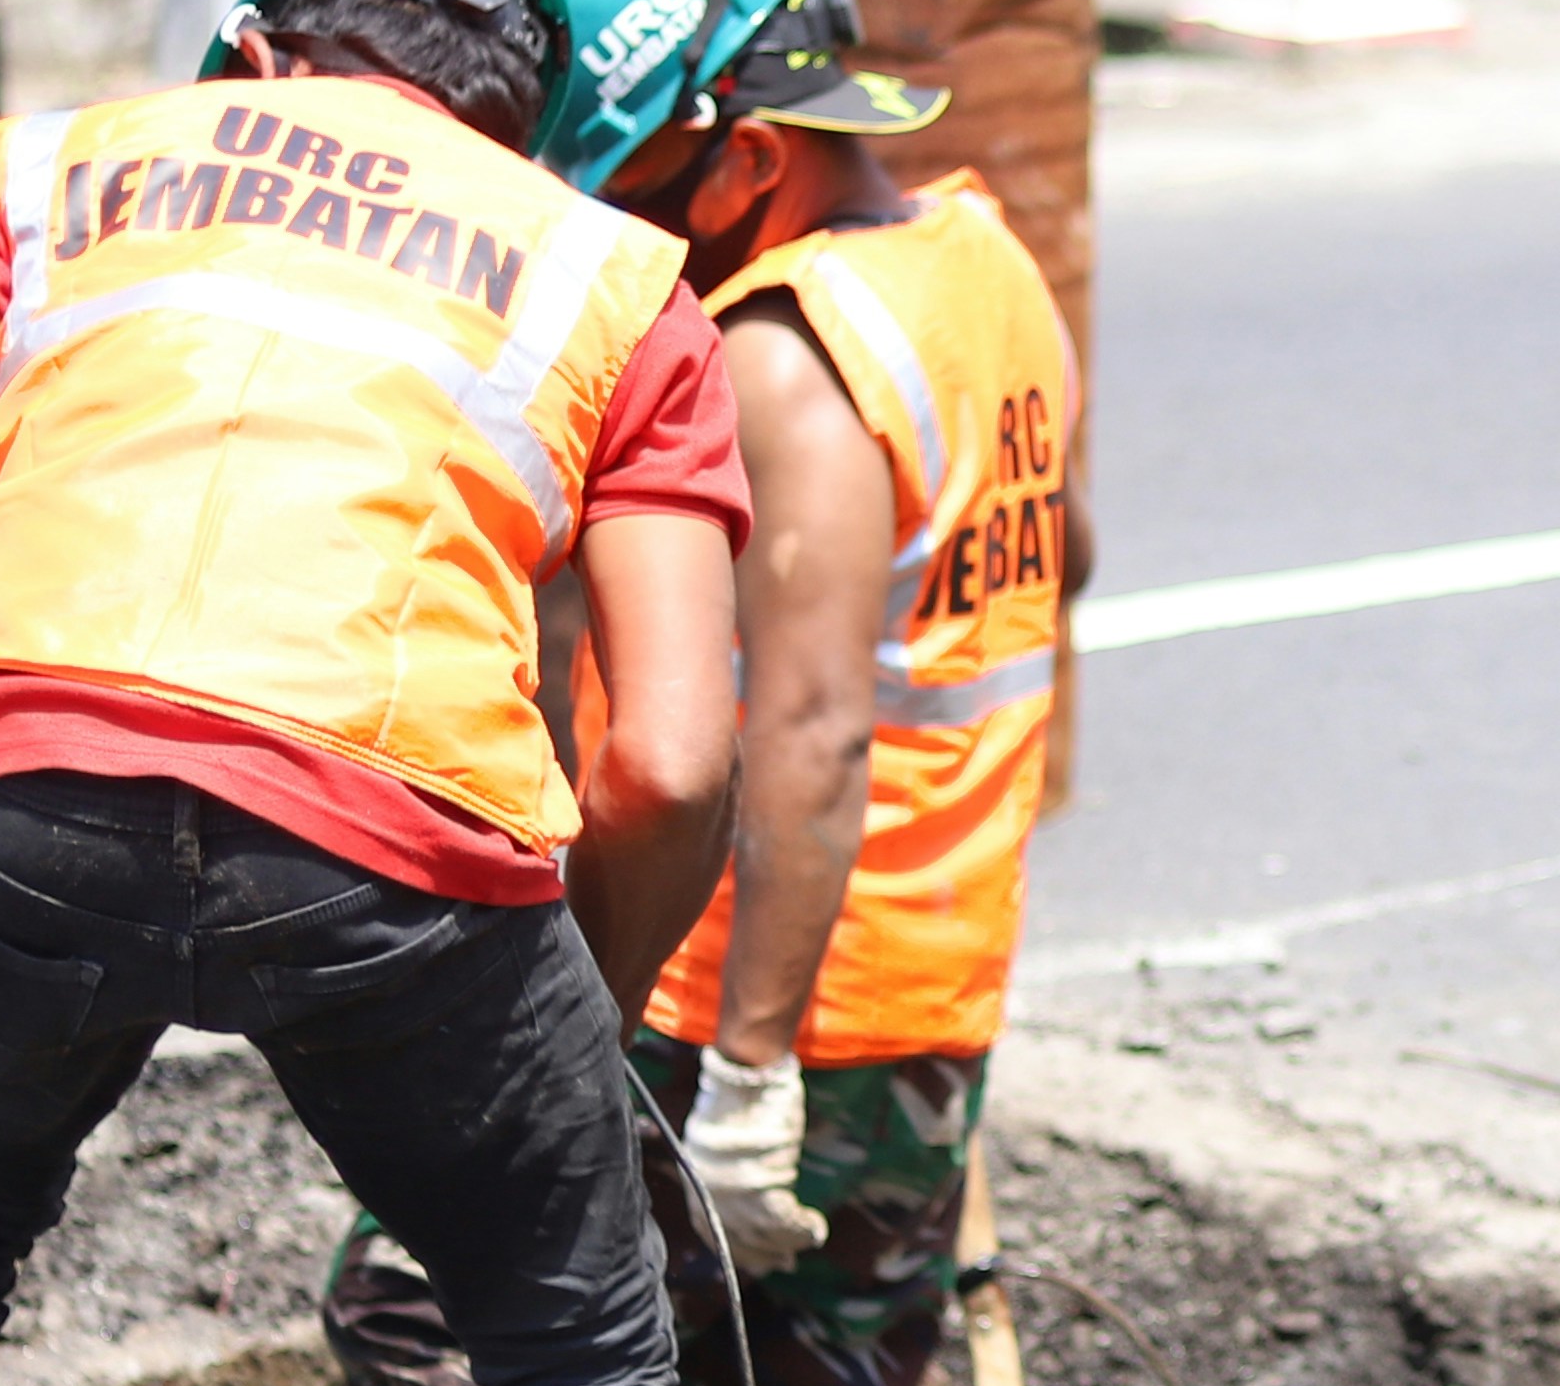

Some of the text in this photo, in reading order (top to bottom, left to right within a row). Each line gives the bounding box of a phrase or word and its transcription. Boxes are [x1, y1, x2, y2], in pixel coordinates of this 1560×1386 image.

[211, 105, 411, 195] URC
[54, 157, 526, 320] JEMBATAN
[997, 387, 1052, 485] RC
[915, 491, 1066, 621] JEBAT
